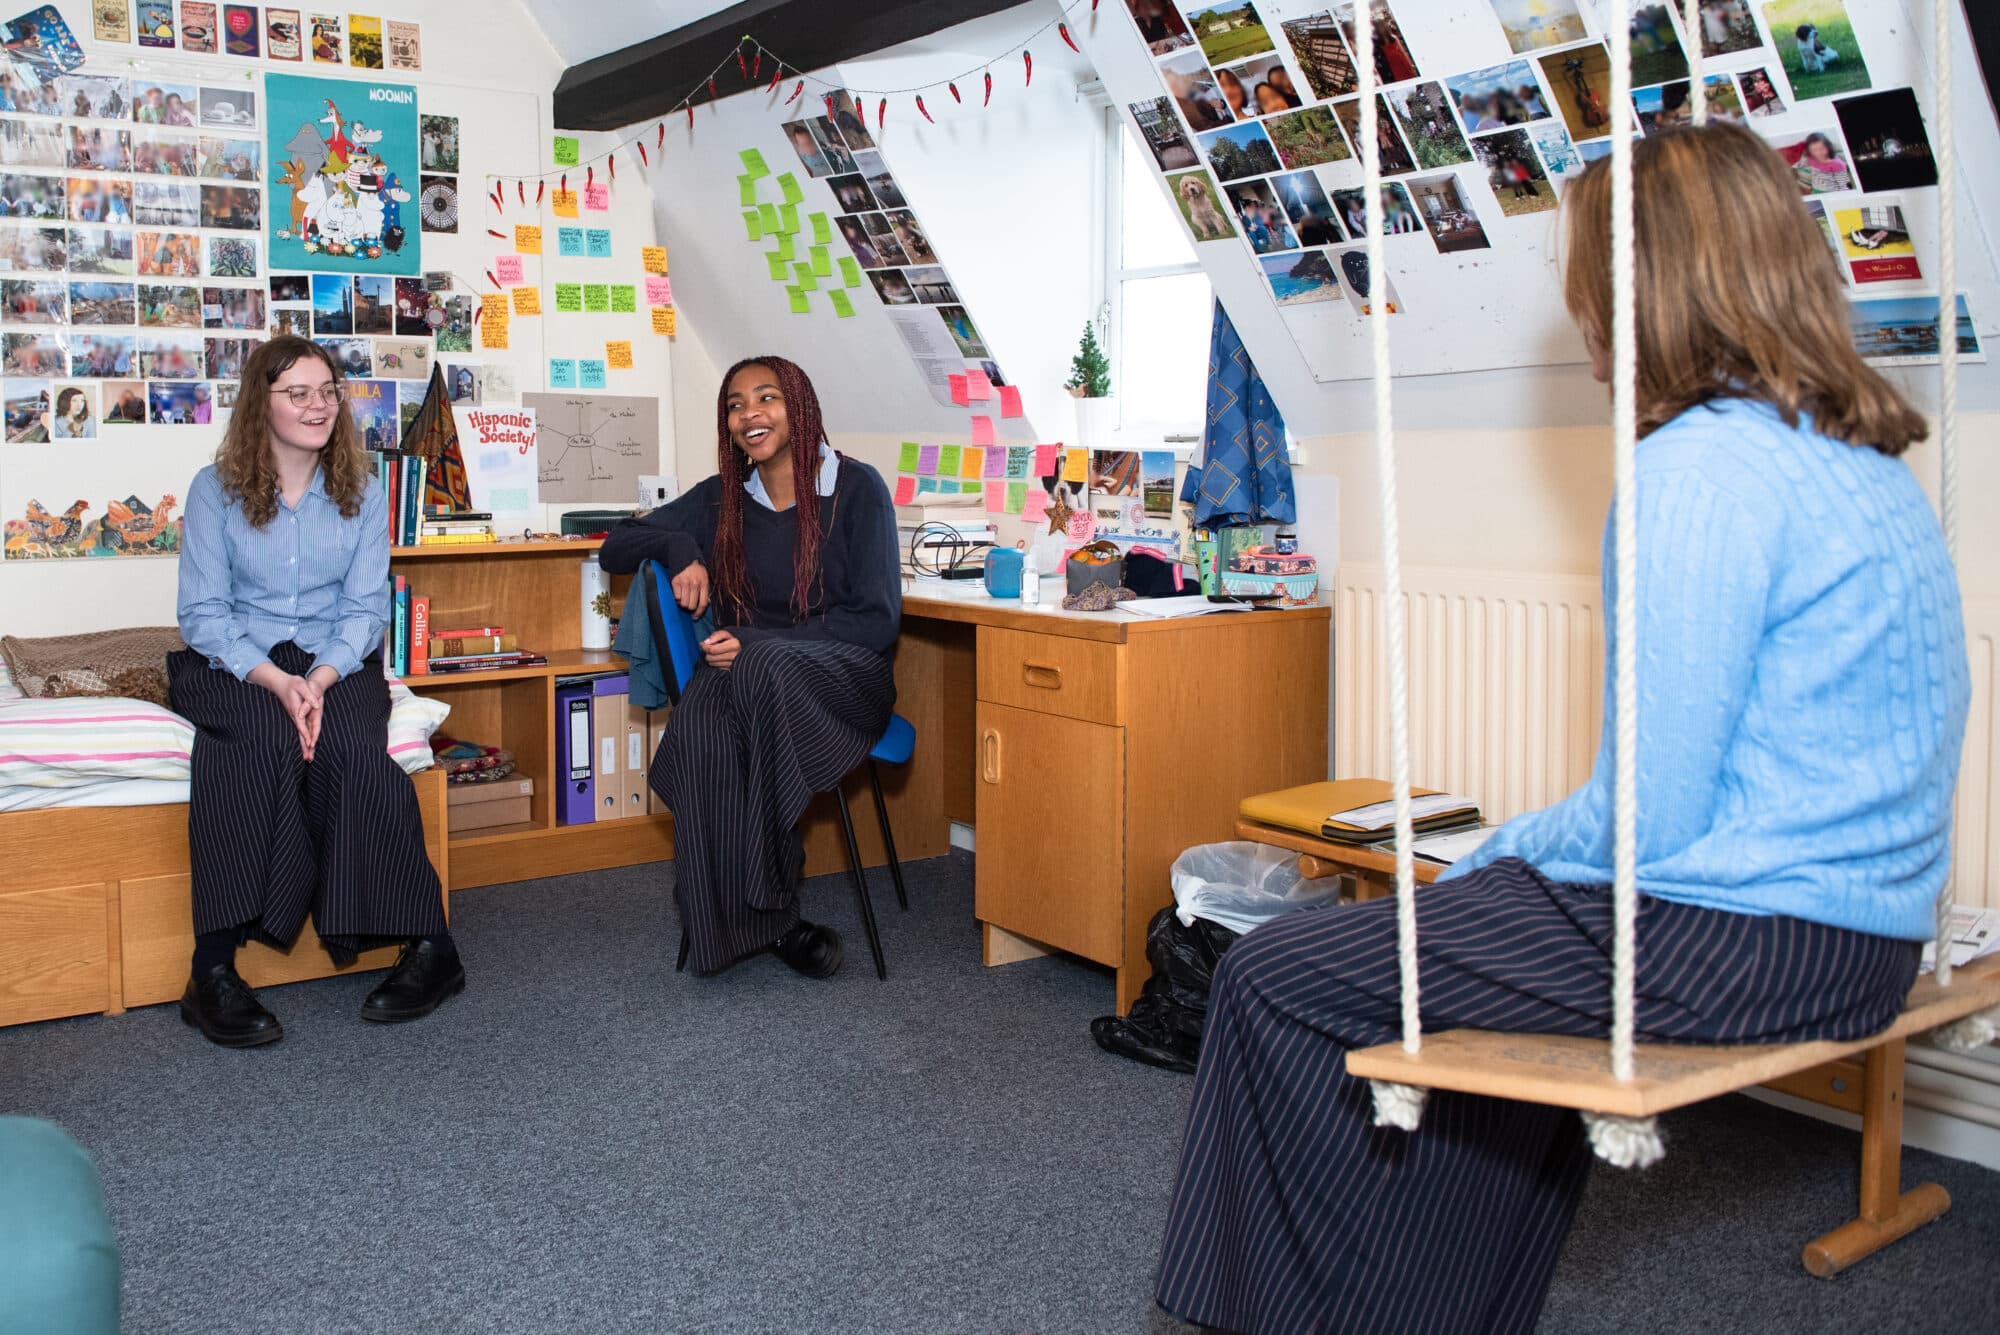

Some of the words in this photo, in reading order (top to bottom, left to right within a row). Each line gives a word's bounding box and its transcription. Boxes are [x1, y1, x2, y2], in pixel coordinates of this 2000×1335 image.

[369, 88, 413, 104] MOOMIN
[467, 411, 532, 432] Hispanic
[479, 427, 536, 455] Society!
[414, 603, 426, 647] Collins
